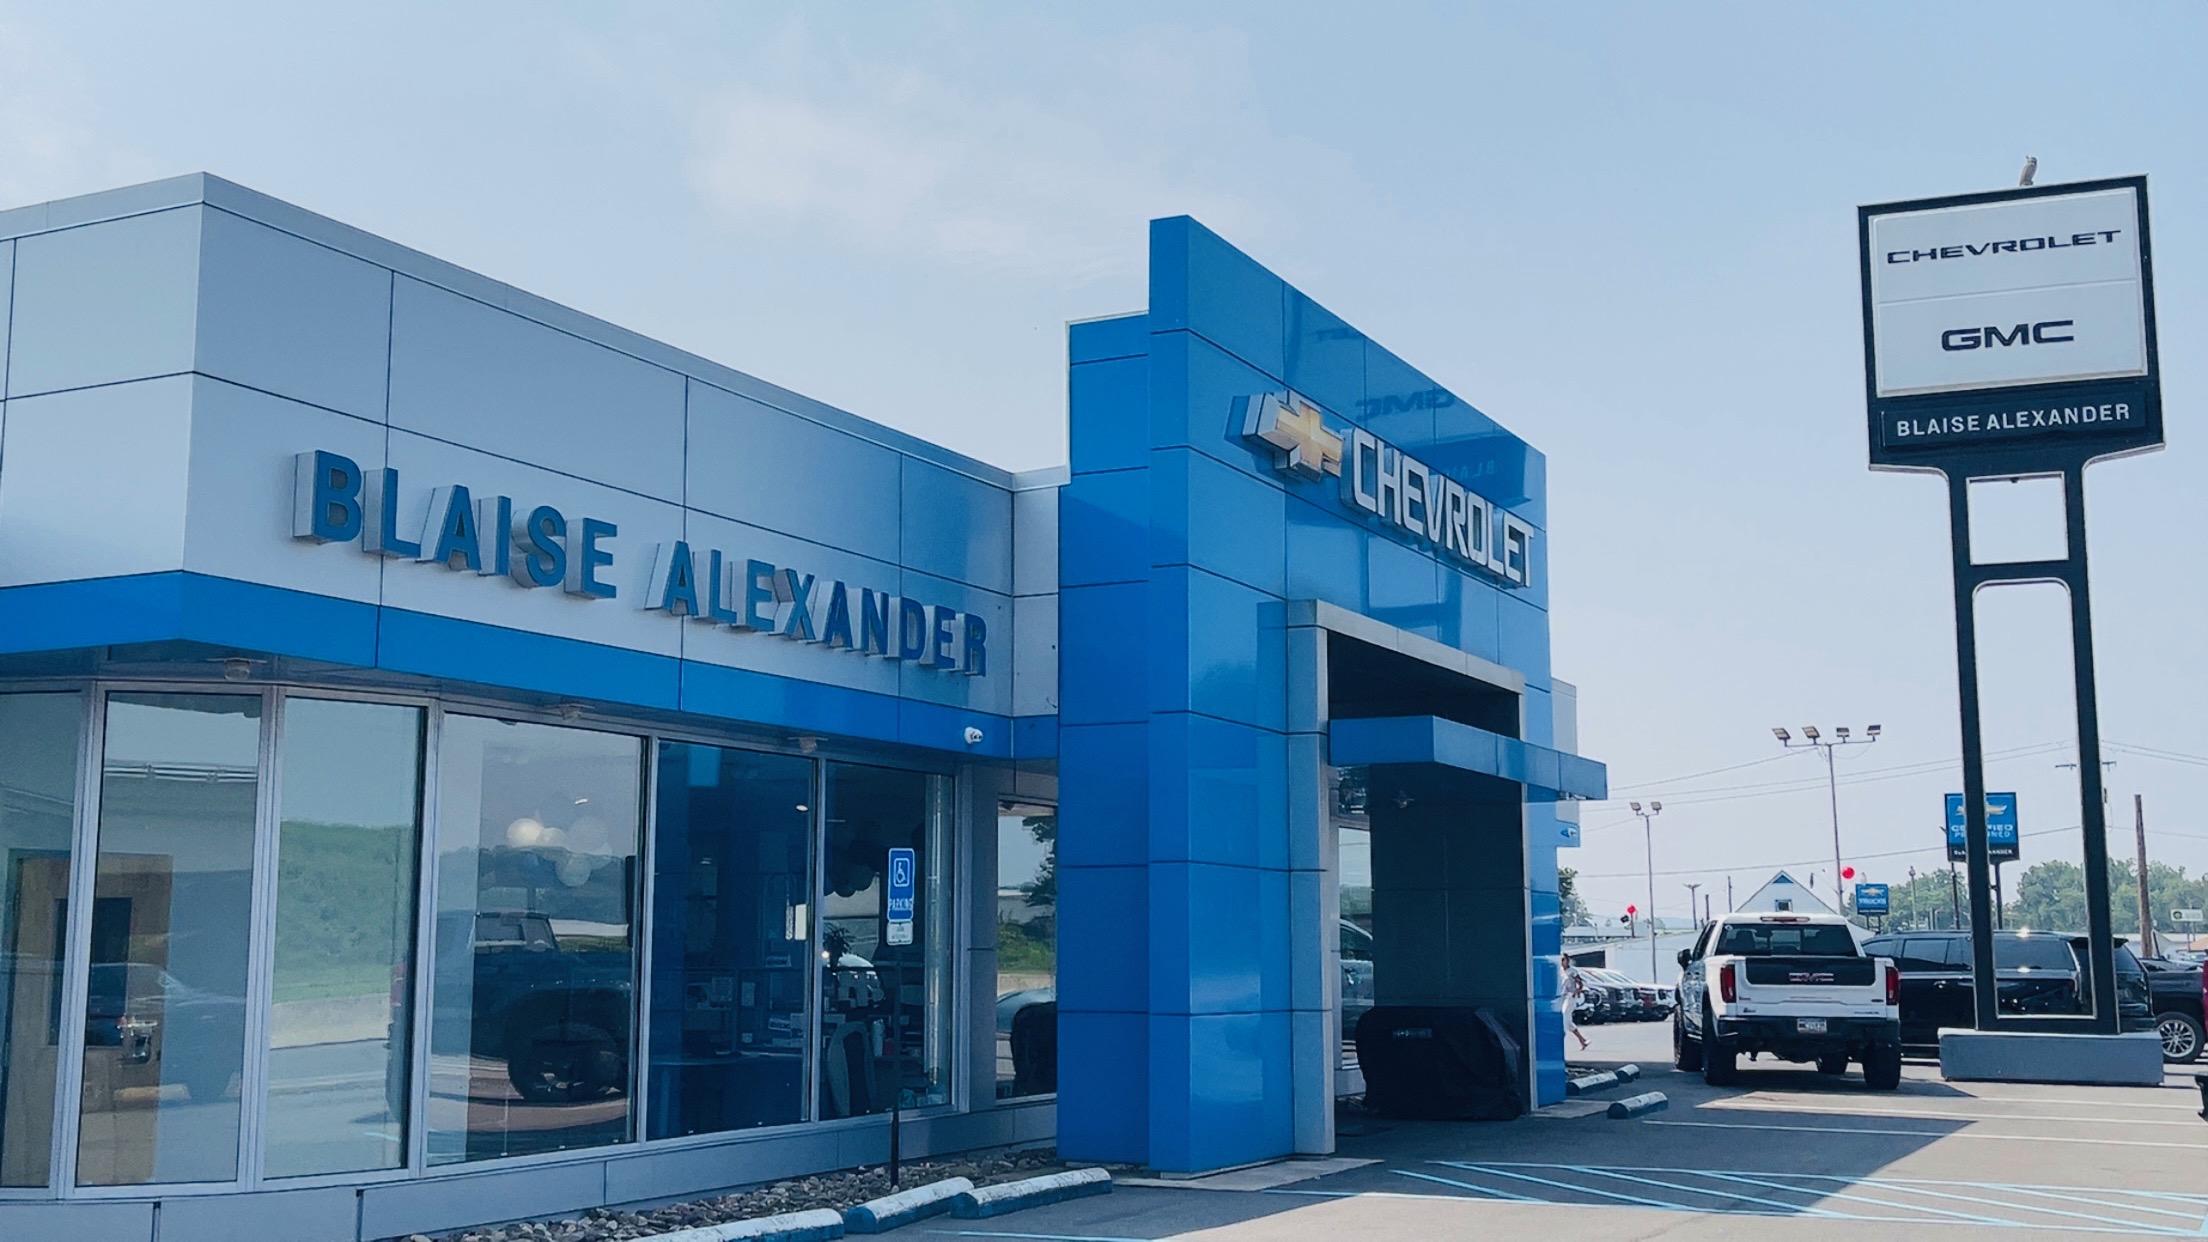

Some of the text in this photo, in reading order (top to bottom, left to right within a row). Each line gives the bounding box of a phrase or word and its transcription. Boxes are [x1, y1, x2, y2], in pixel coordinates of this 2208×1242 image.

[1887, 230, 2121, 264] CHEVROLET
[1941, 320, 2075, 351] GMC
[1897, 403, 2130, 437] BLAISE ALEXANDER
[1350, 427, 1534, 588] CHEVROLET
[292, 449, 988, 677] BLAISE ALEXANDER
